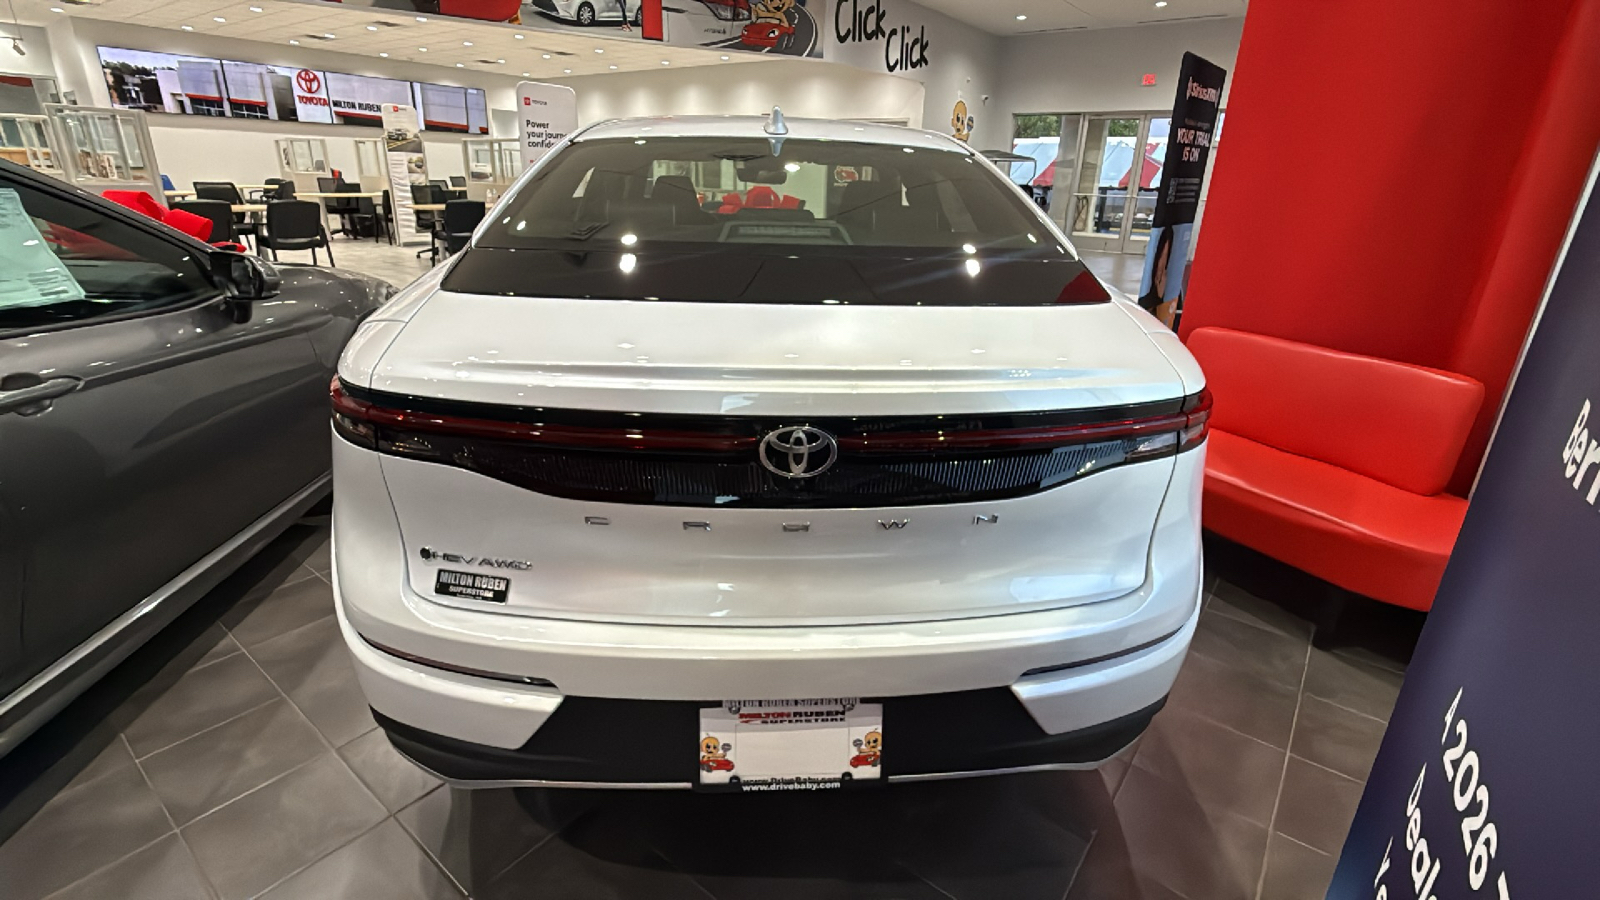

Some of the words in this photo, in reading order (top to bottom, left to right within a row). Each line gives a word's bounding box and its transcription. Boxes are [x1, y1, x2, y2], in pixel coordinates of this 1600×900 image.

[834, 0, 886, 44] Click
[885, 25, 929, 73] Click
[296, 94, 329, 107] TOYOTA
[331, 99, 357, 111] MILTON
[357, 102, 382, 113] RUBEN
[525, 119, 550, 129] Power
[526, 131, 544, 139] your
[1176, 127, 1196, 145] YOUR
[1194, 130, 1211, 148] TRIAL
[1182, 146, 1191, 162] IS
[1189, 147, 1200, 162] ON
[477, 557, 533, 571] AWD
[439, 571, 475, 587] MILTON
[474, 575, 507, 591] RUBEN
[448, 585, 495, 598] SUPERSTORE
[792, 709, 846, 718] RUBEN
[741, 782, 841, 792] www.drivebaby.com
[1443, 719, 1499, 891] 2026
